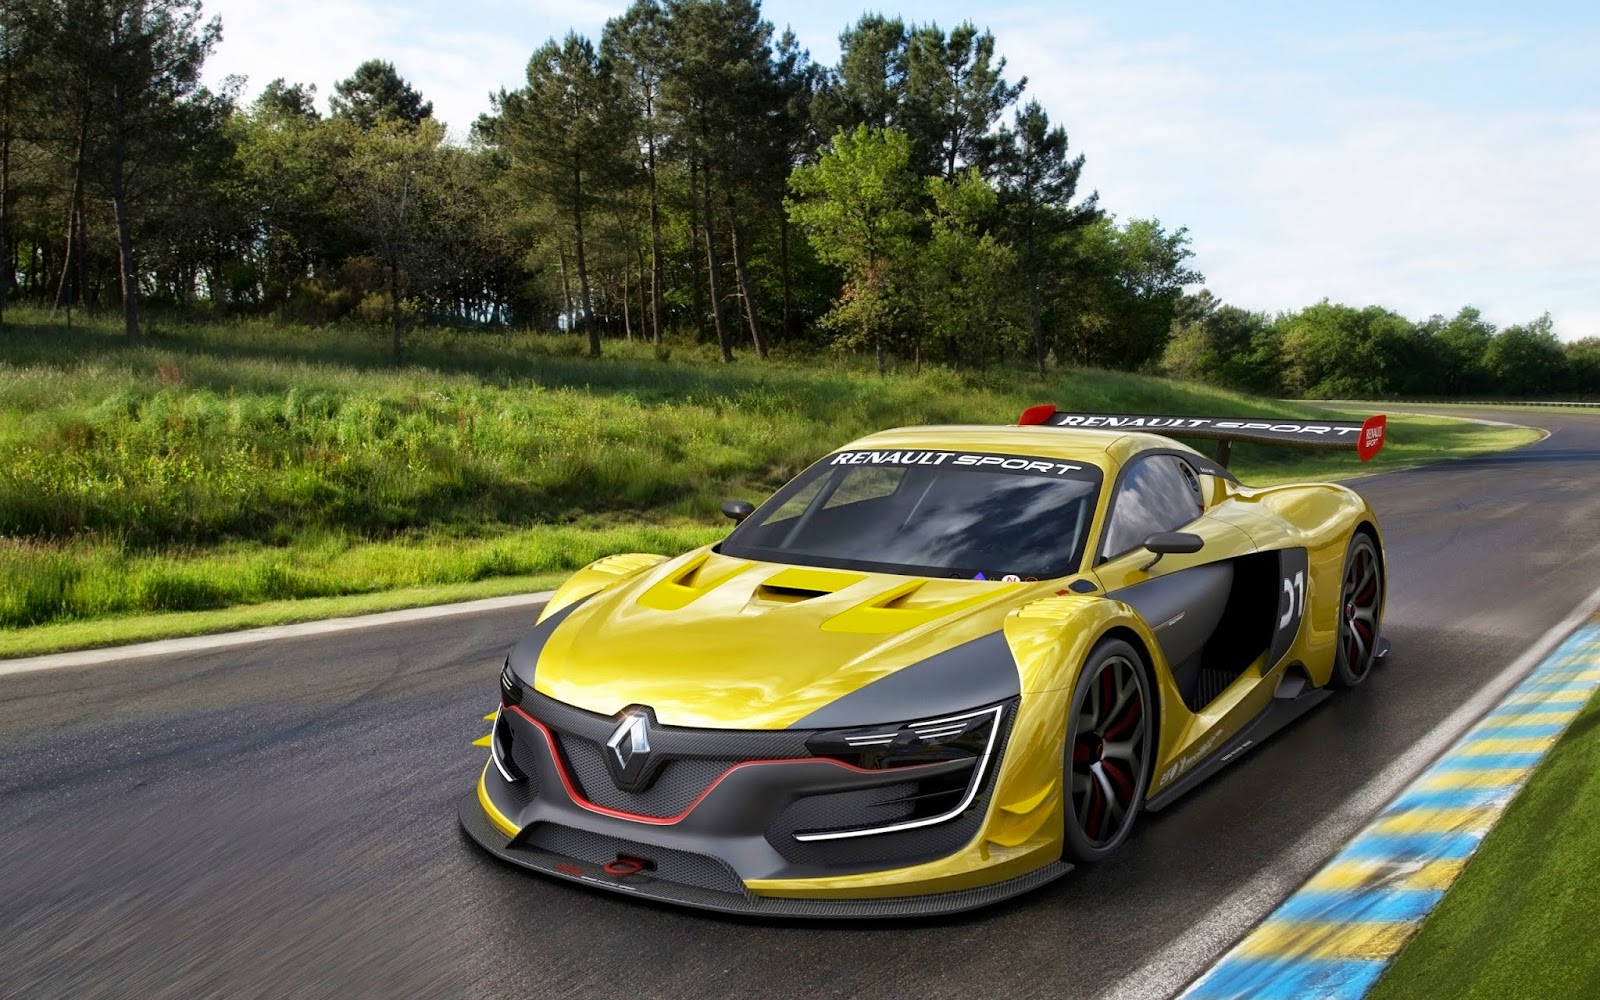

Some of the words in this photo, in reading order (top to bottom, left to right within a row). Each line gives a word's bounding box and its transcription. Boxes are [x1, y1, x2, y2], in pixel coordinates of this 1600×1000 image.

[1058, 415, 1211, 428] RENAULT
[1211, 421, 1363, 435] SPORT
[1366, 426, 1382, 440] RENAULT
[1366, 438, 1378, 447] SPORT
[830, 452, 957, 465] RENAULT
[953, 455, 1082, 474] SPORT
